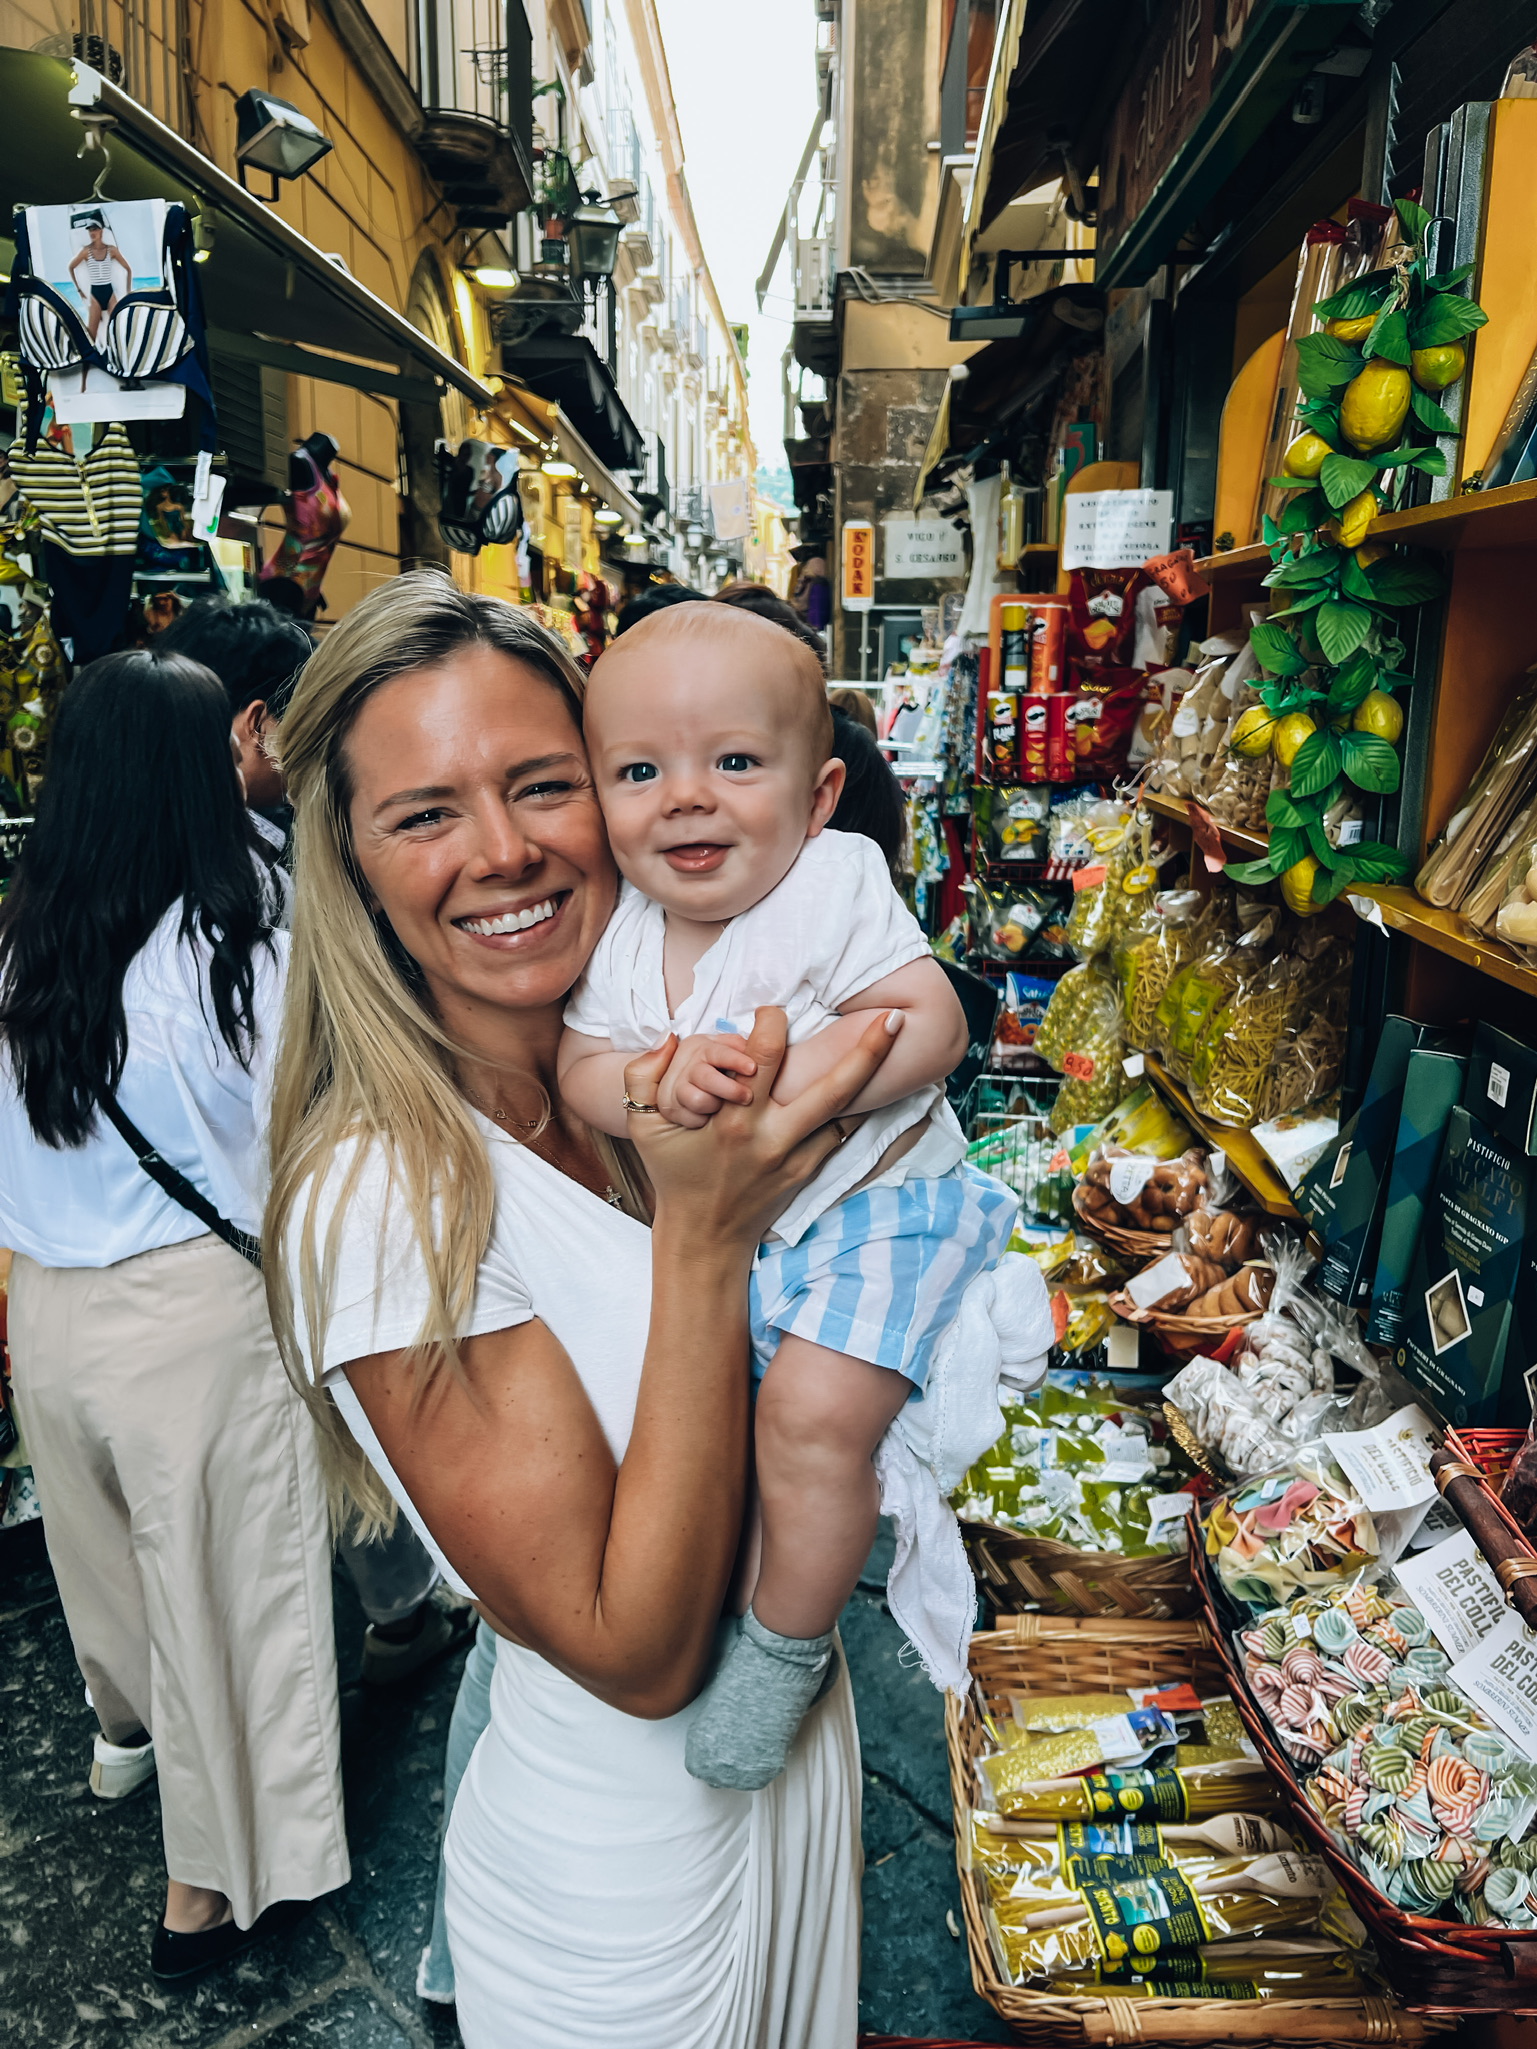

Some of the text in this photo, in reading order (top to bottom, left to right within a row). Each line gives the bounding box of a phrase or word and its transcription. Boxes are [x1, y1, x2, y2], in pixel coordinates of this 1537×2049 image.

[852, 531, 867, 594] KODAK
[1467, 1137, 1511, 1171] PASTIFICIO
[1435, 1566, 1465, 1598] DEL
[1457, 1595, 1492, 1639] COLL
[1489, 1653, 1519, 1681] DEL
[1504, 1639, 1537, 1675] PAST
